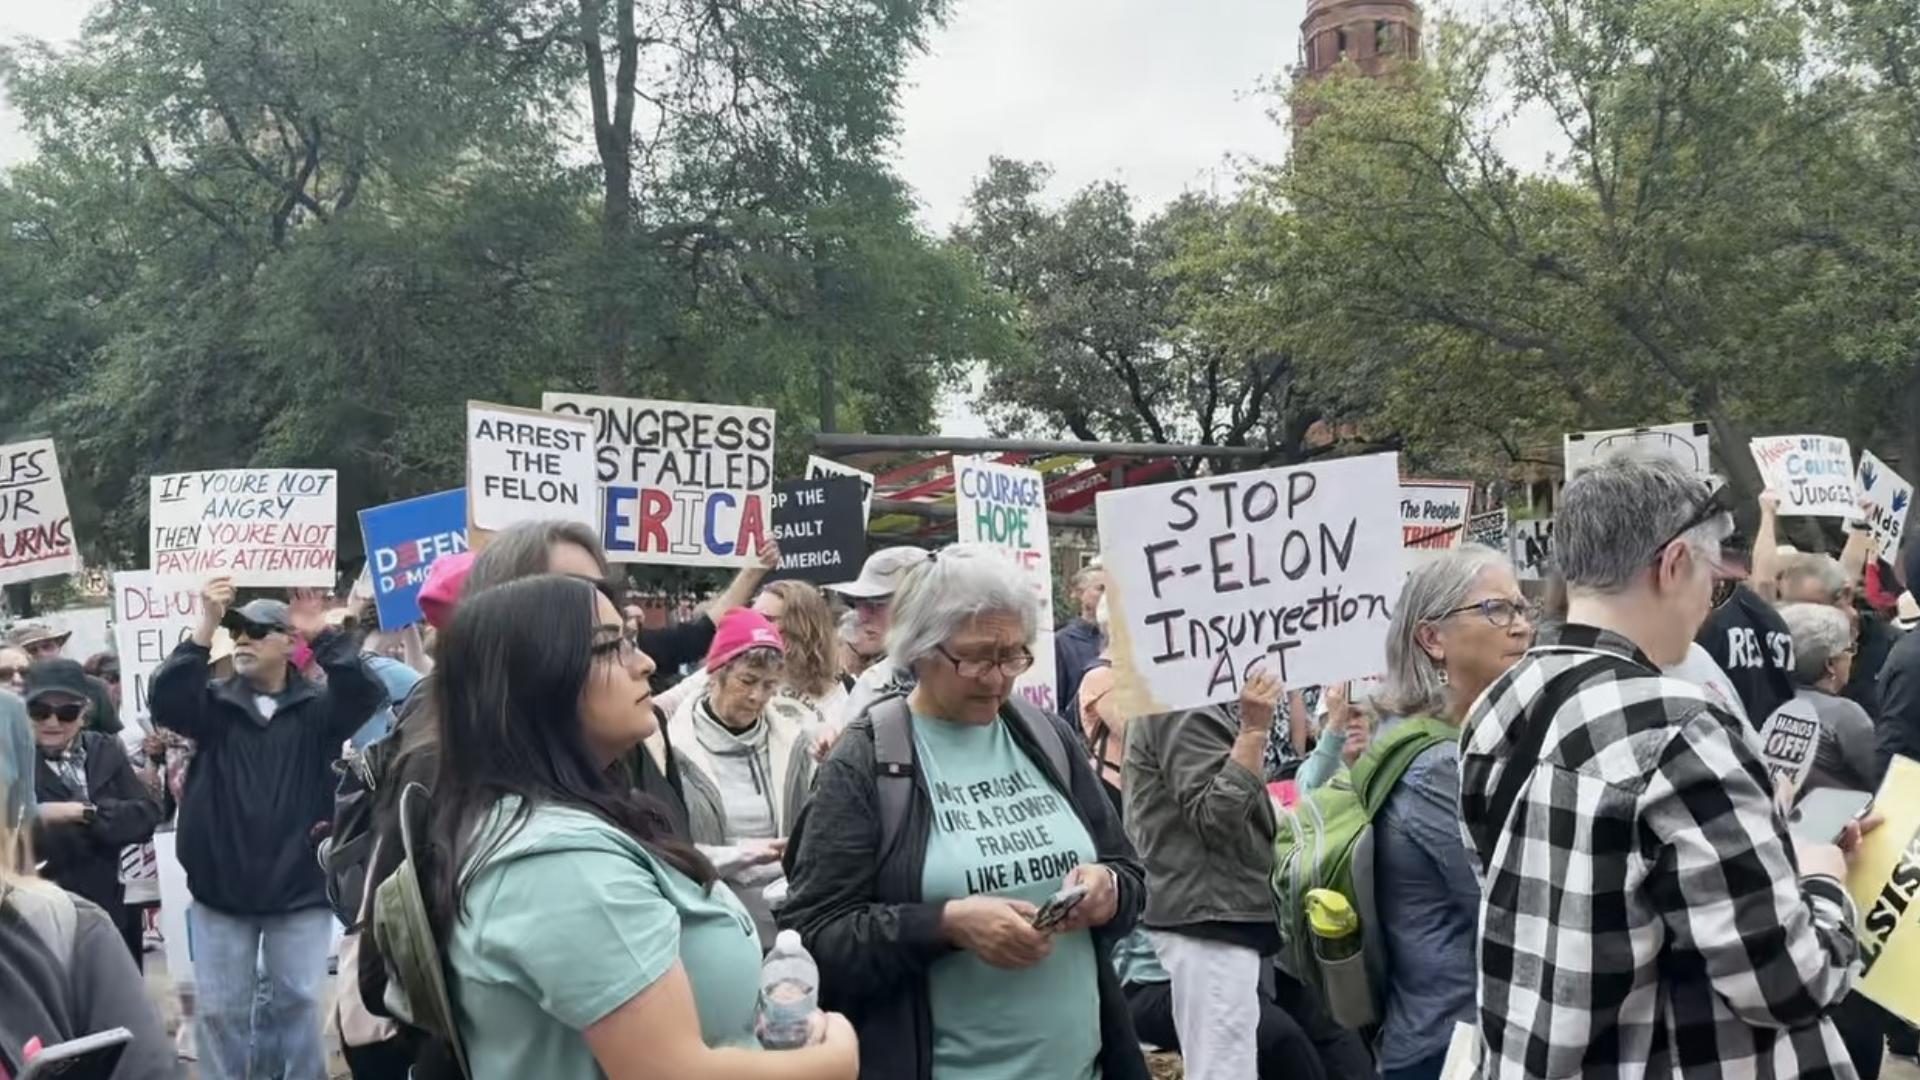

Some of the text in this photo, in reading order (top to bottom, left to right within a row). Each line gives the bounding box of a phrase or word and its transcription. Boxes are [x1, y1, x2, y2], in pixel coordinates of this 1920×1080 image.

[475, 419, 586, 451] ARREST
[506, 449, 561, 475] THE
[632, 447, 771, 491] FAILED
[159, 475, 193, 498] IF
[277, 471, 334, 495] NOT
[484, 475, 578, 504] FELON
[796, 488, 825, 506] THE
[961, 468, 1042, 508] COURAGE
[202, 497, 295, 520] ANGRY
[1168, 471, 1316, 531] STOP
[1401, 500, 1421, 519] The
[1423, 500, 1460, 523] People
[600, 486, 768, 556] ERICA
[774, 520, 823, 539] SAULT
[976, 500, 1032, 549] HOPE
[155, 525, 201, 549] THEN
[282, 523, 334, 546] NOT
[1402, 526, 1457, 549] TRUMP
[156, 548, 335, 575] PAYING ATTENTION
[776, 549, 841, 571] AMERICA
[1144, 517, 1357, 598] F-ELON
[1144, 586, 1392, 663] Insurrection
[1768, 733, 1808, 760] OFF!
[935, 781, 966, 805] NT
[977, 809, 994, 829] A
[992, 795, 1059, 827] FLOWER
[976, 825, 1053, 857] FRAGILE
[966, 864, 1008, 894] LIKE
[1014, 860, 1027, 885] A
